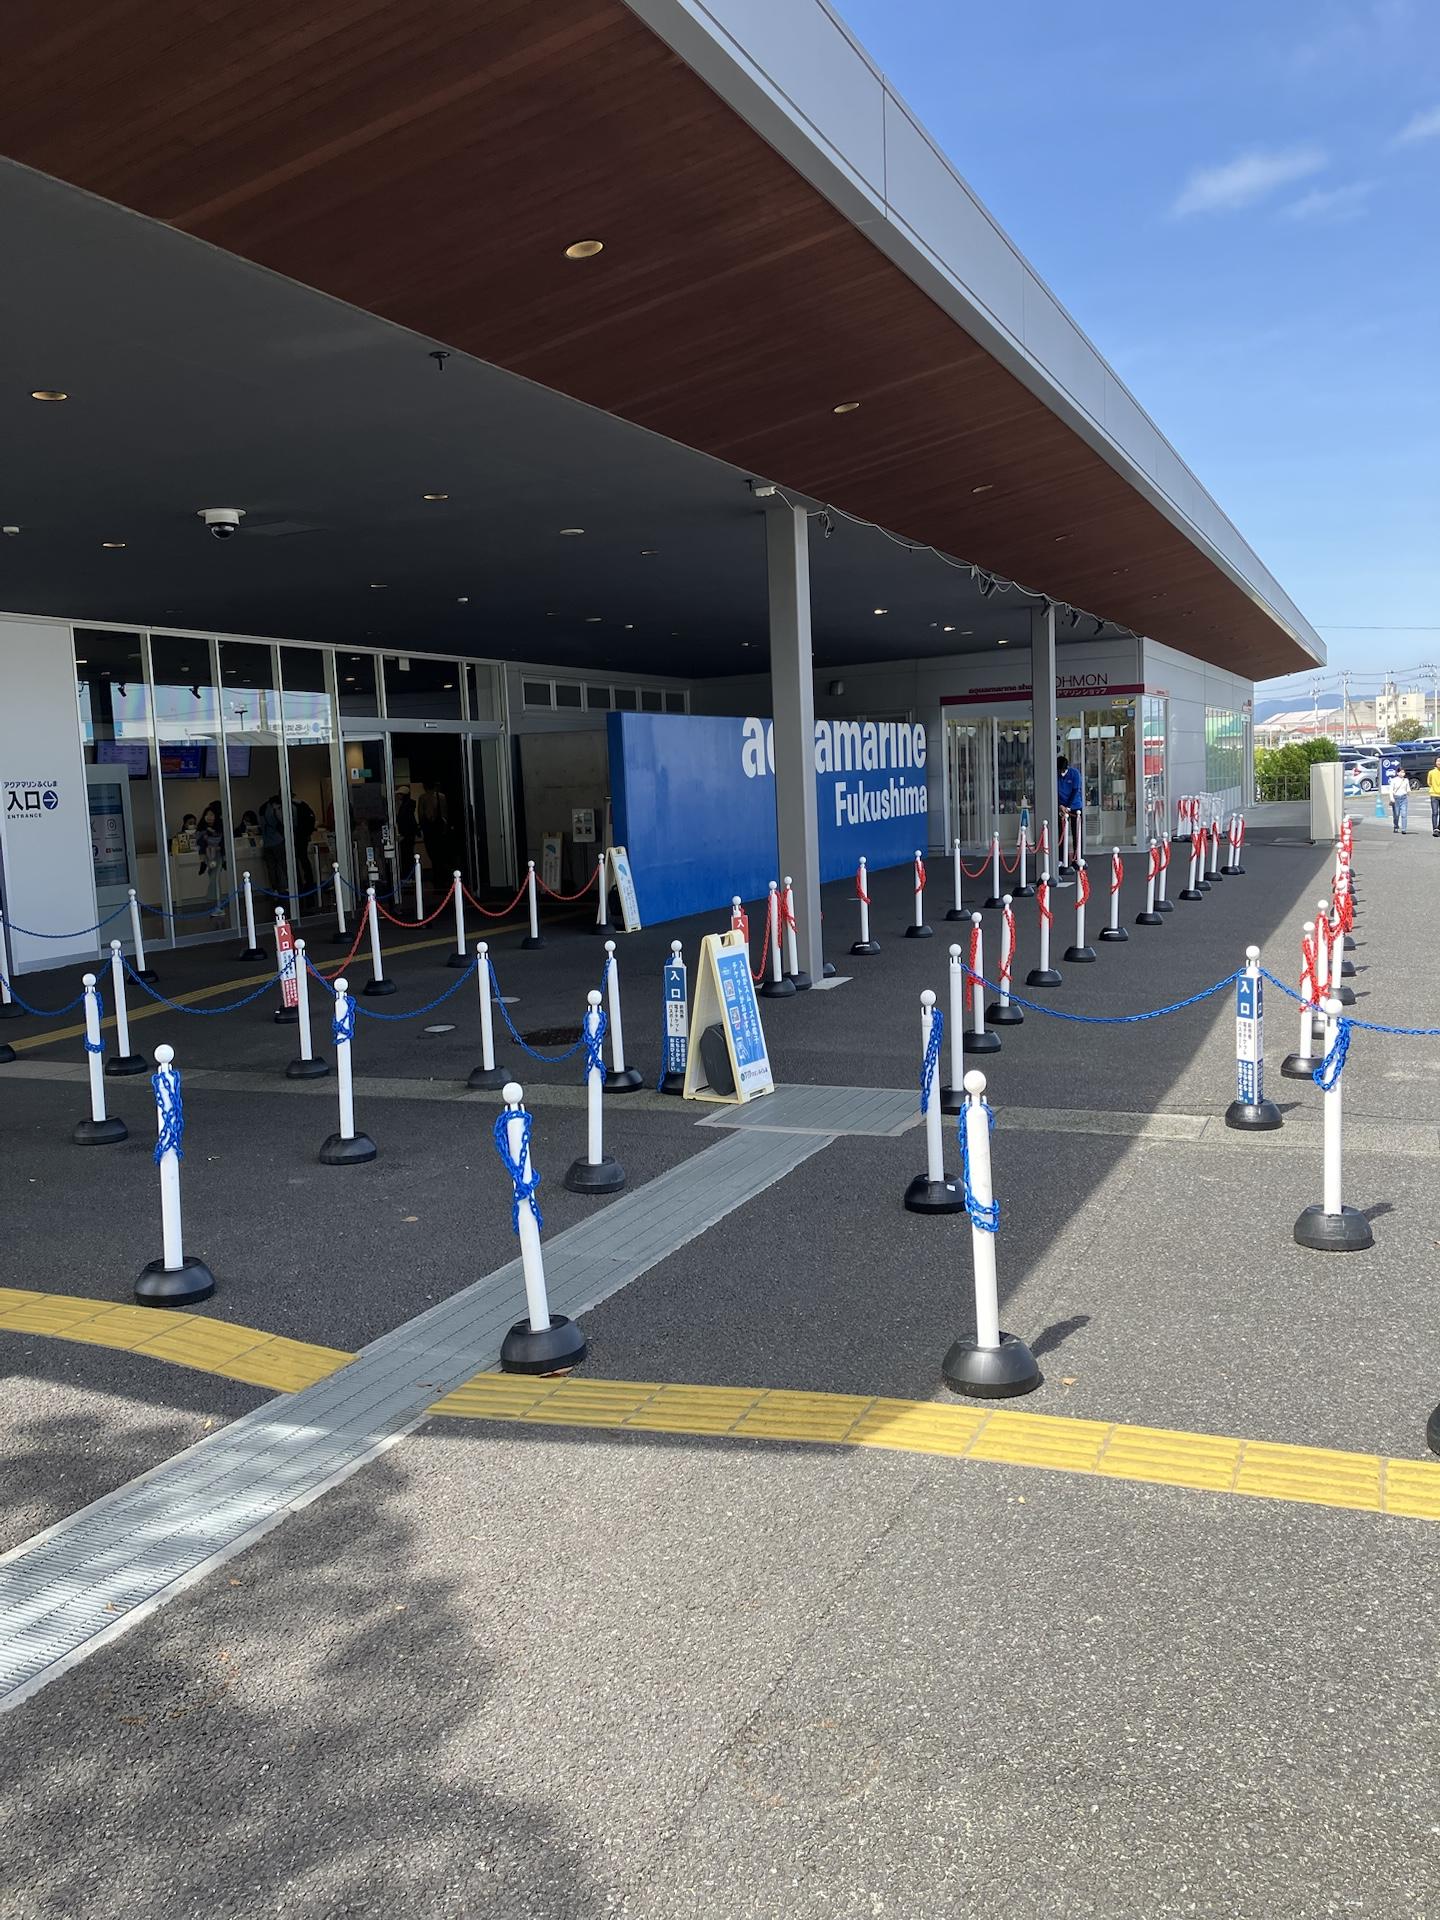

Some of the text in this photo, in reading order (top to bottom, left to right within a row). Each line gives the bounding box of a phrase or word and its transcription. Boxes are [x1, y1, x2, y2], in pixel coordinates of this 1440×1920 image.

[741, 717, 927, 778] aamarine
[7, 791, 41, 811] 入口
[834, 777, 928, 827] Fukushima
[280, 928, 290, 949] 入口
[670, 970, 681, 998] 入口
[1240, 981, 1250, 1015] 入口
